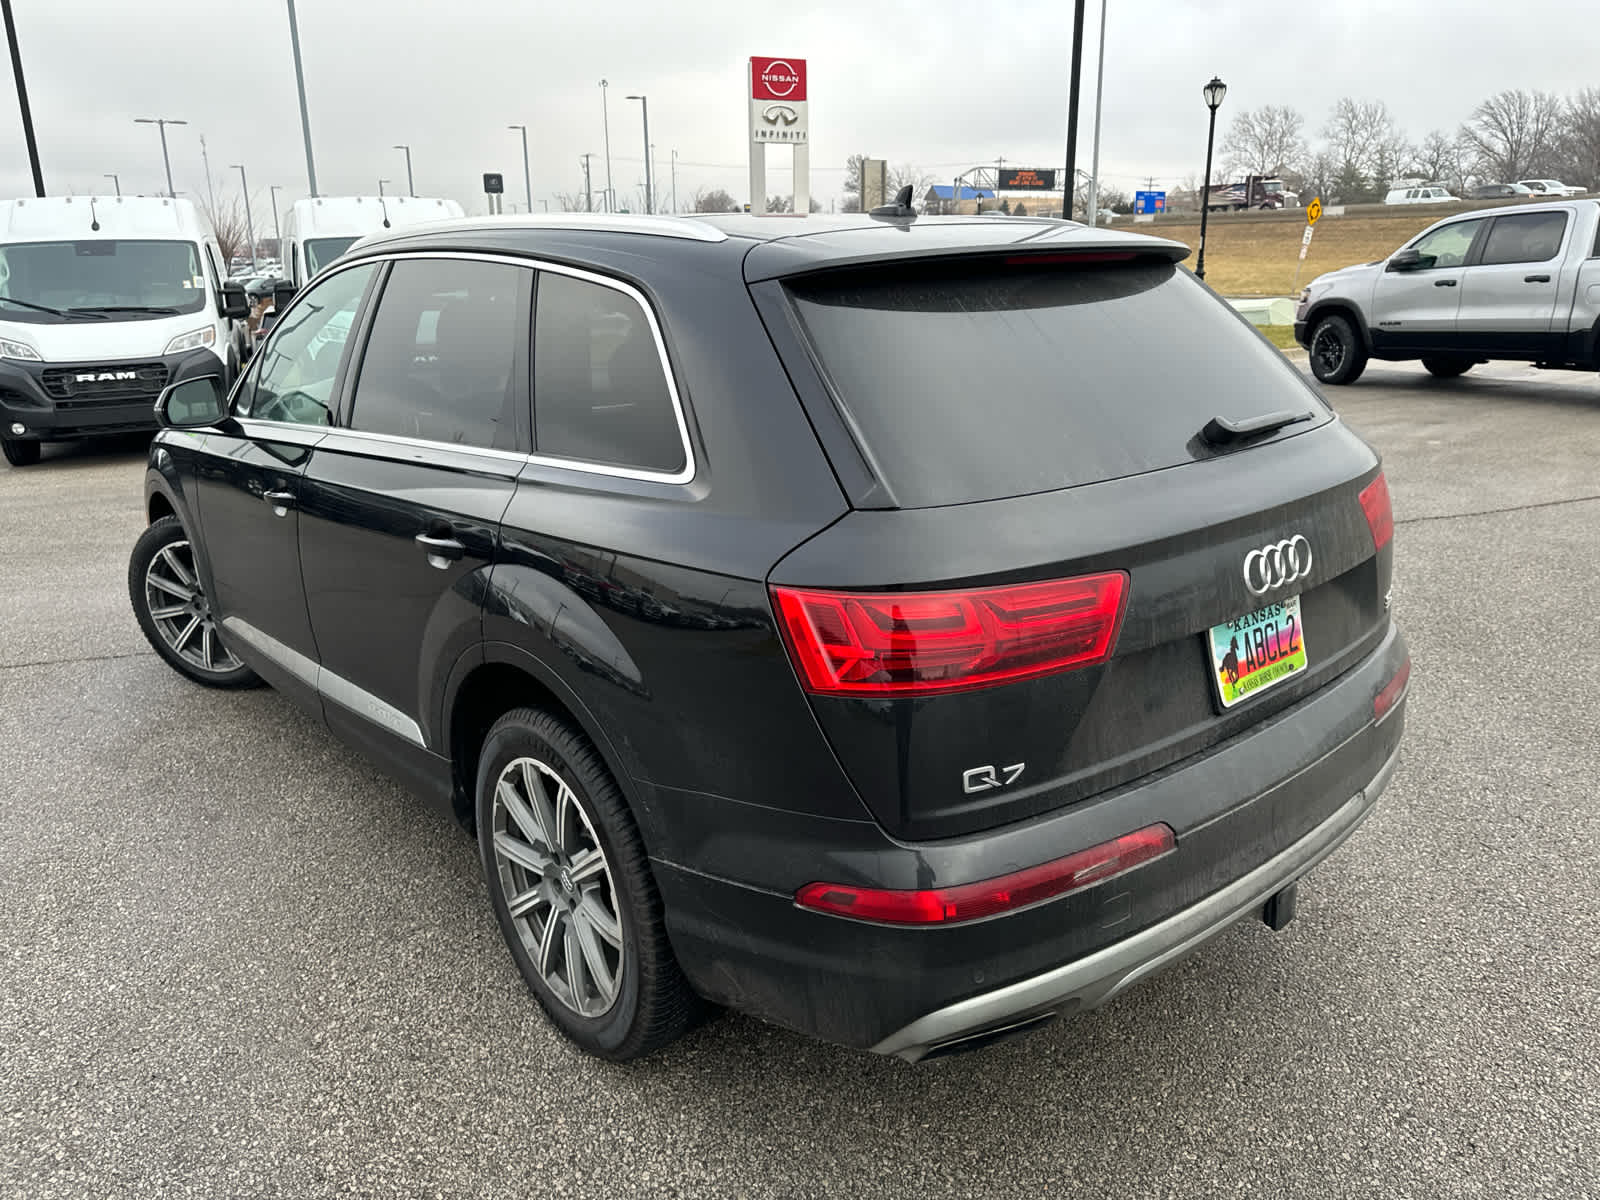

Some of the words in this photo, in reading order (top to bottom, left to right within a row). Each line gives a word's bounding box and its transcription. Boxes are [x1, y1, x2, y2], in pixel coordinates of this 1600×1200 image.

[761, 74, 799, 83] NISSAN
[755, 130, 806, 141] INFINITI
[76, 371, 136, 382] RAM
[1234, 603, 1281, 632] KANSAS
[962, 762, 1025, 794] Q7
